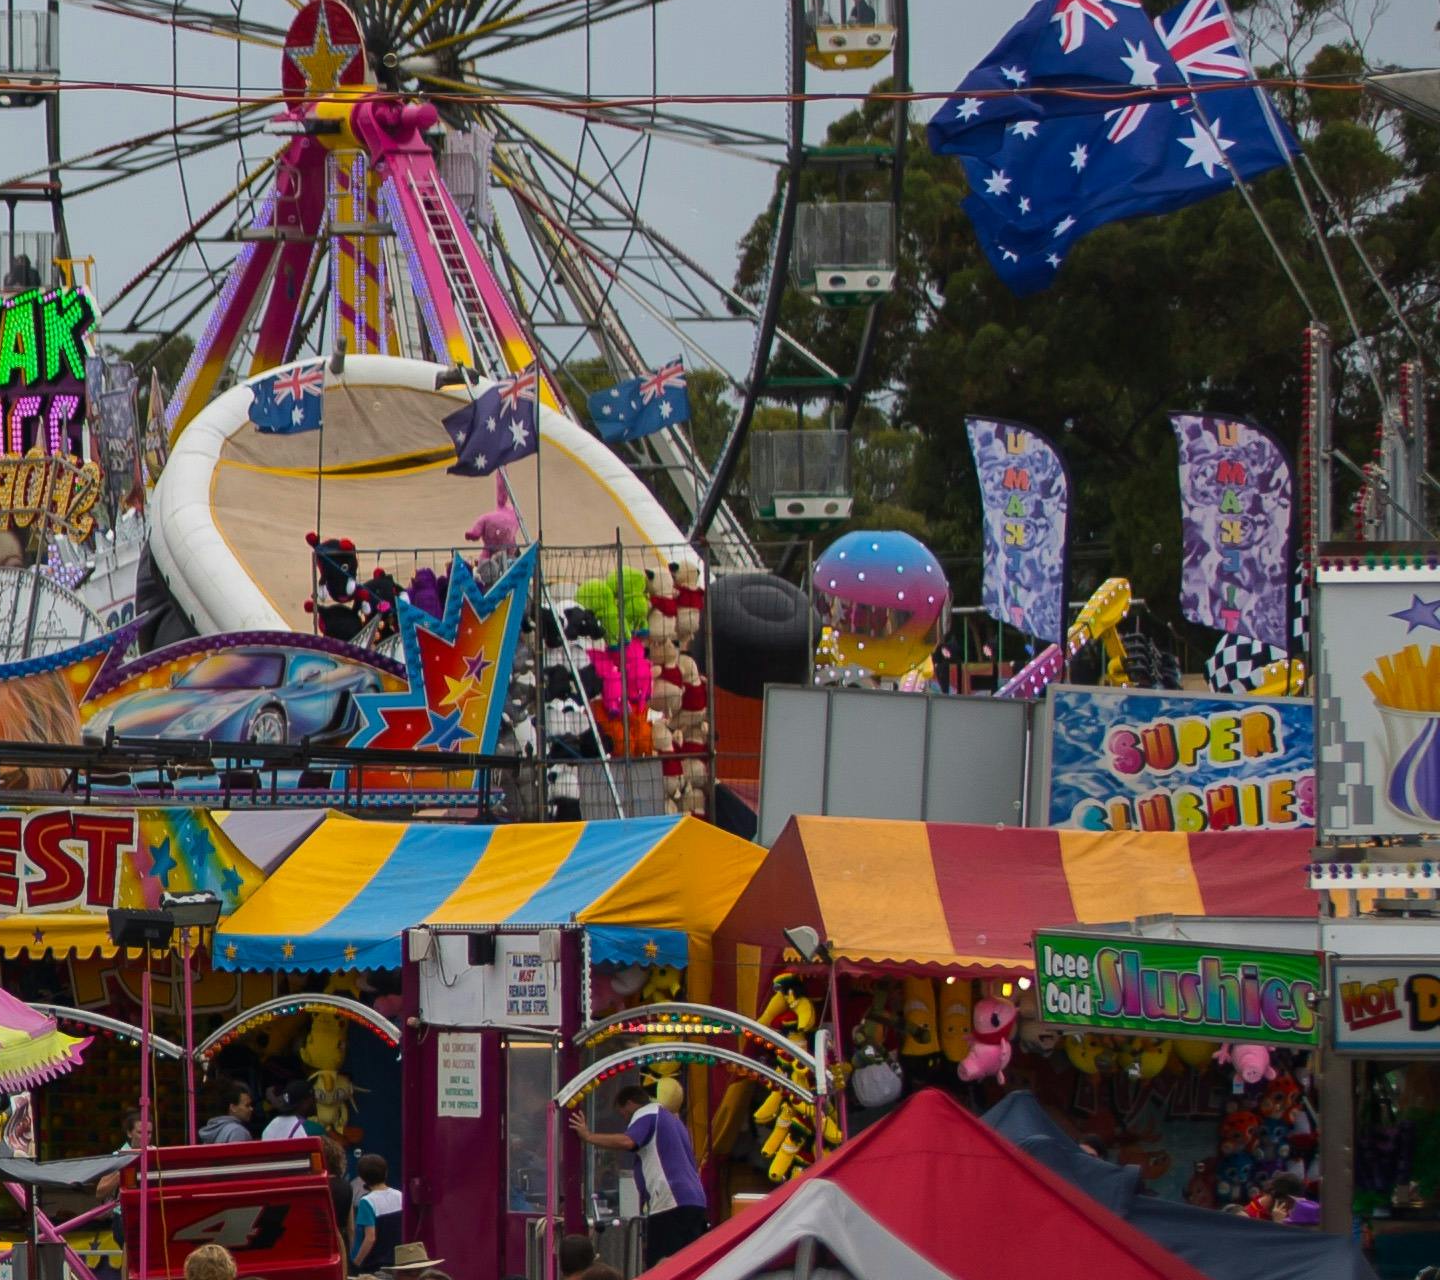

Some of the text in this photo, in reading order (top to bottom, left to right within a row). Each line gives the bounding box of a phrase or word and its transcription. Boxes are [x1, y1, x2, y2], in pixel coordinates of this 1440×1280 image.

[1109, 711, 1280, 775] SUPER
[1044, 946, 1317, 1033] Icee Slushies
[1045, 983, 1091, 1018] Cold
[1338, 978, 1400, 1023] HOT
